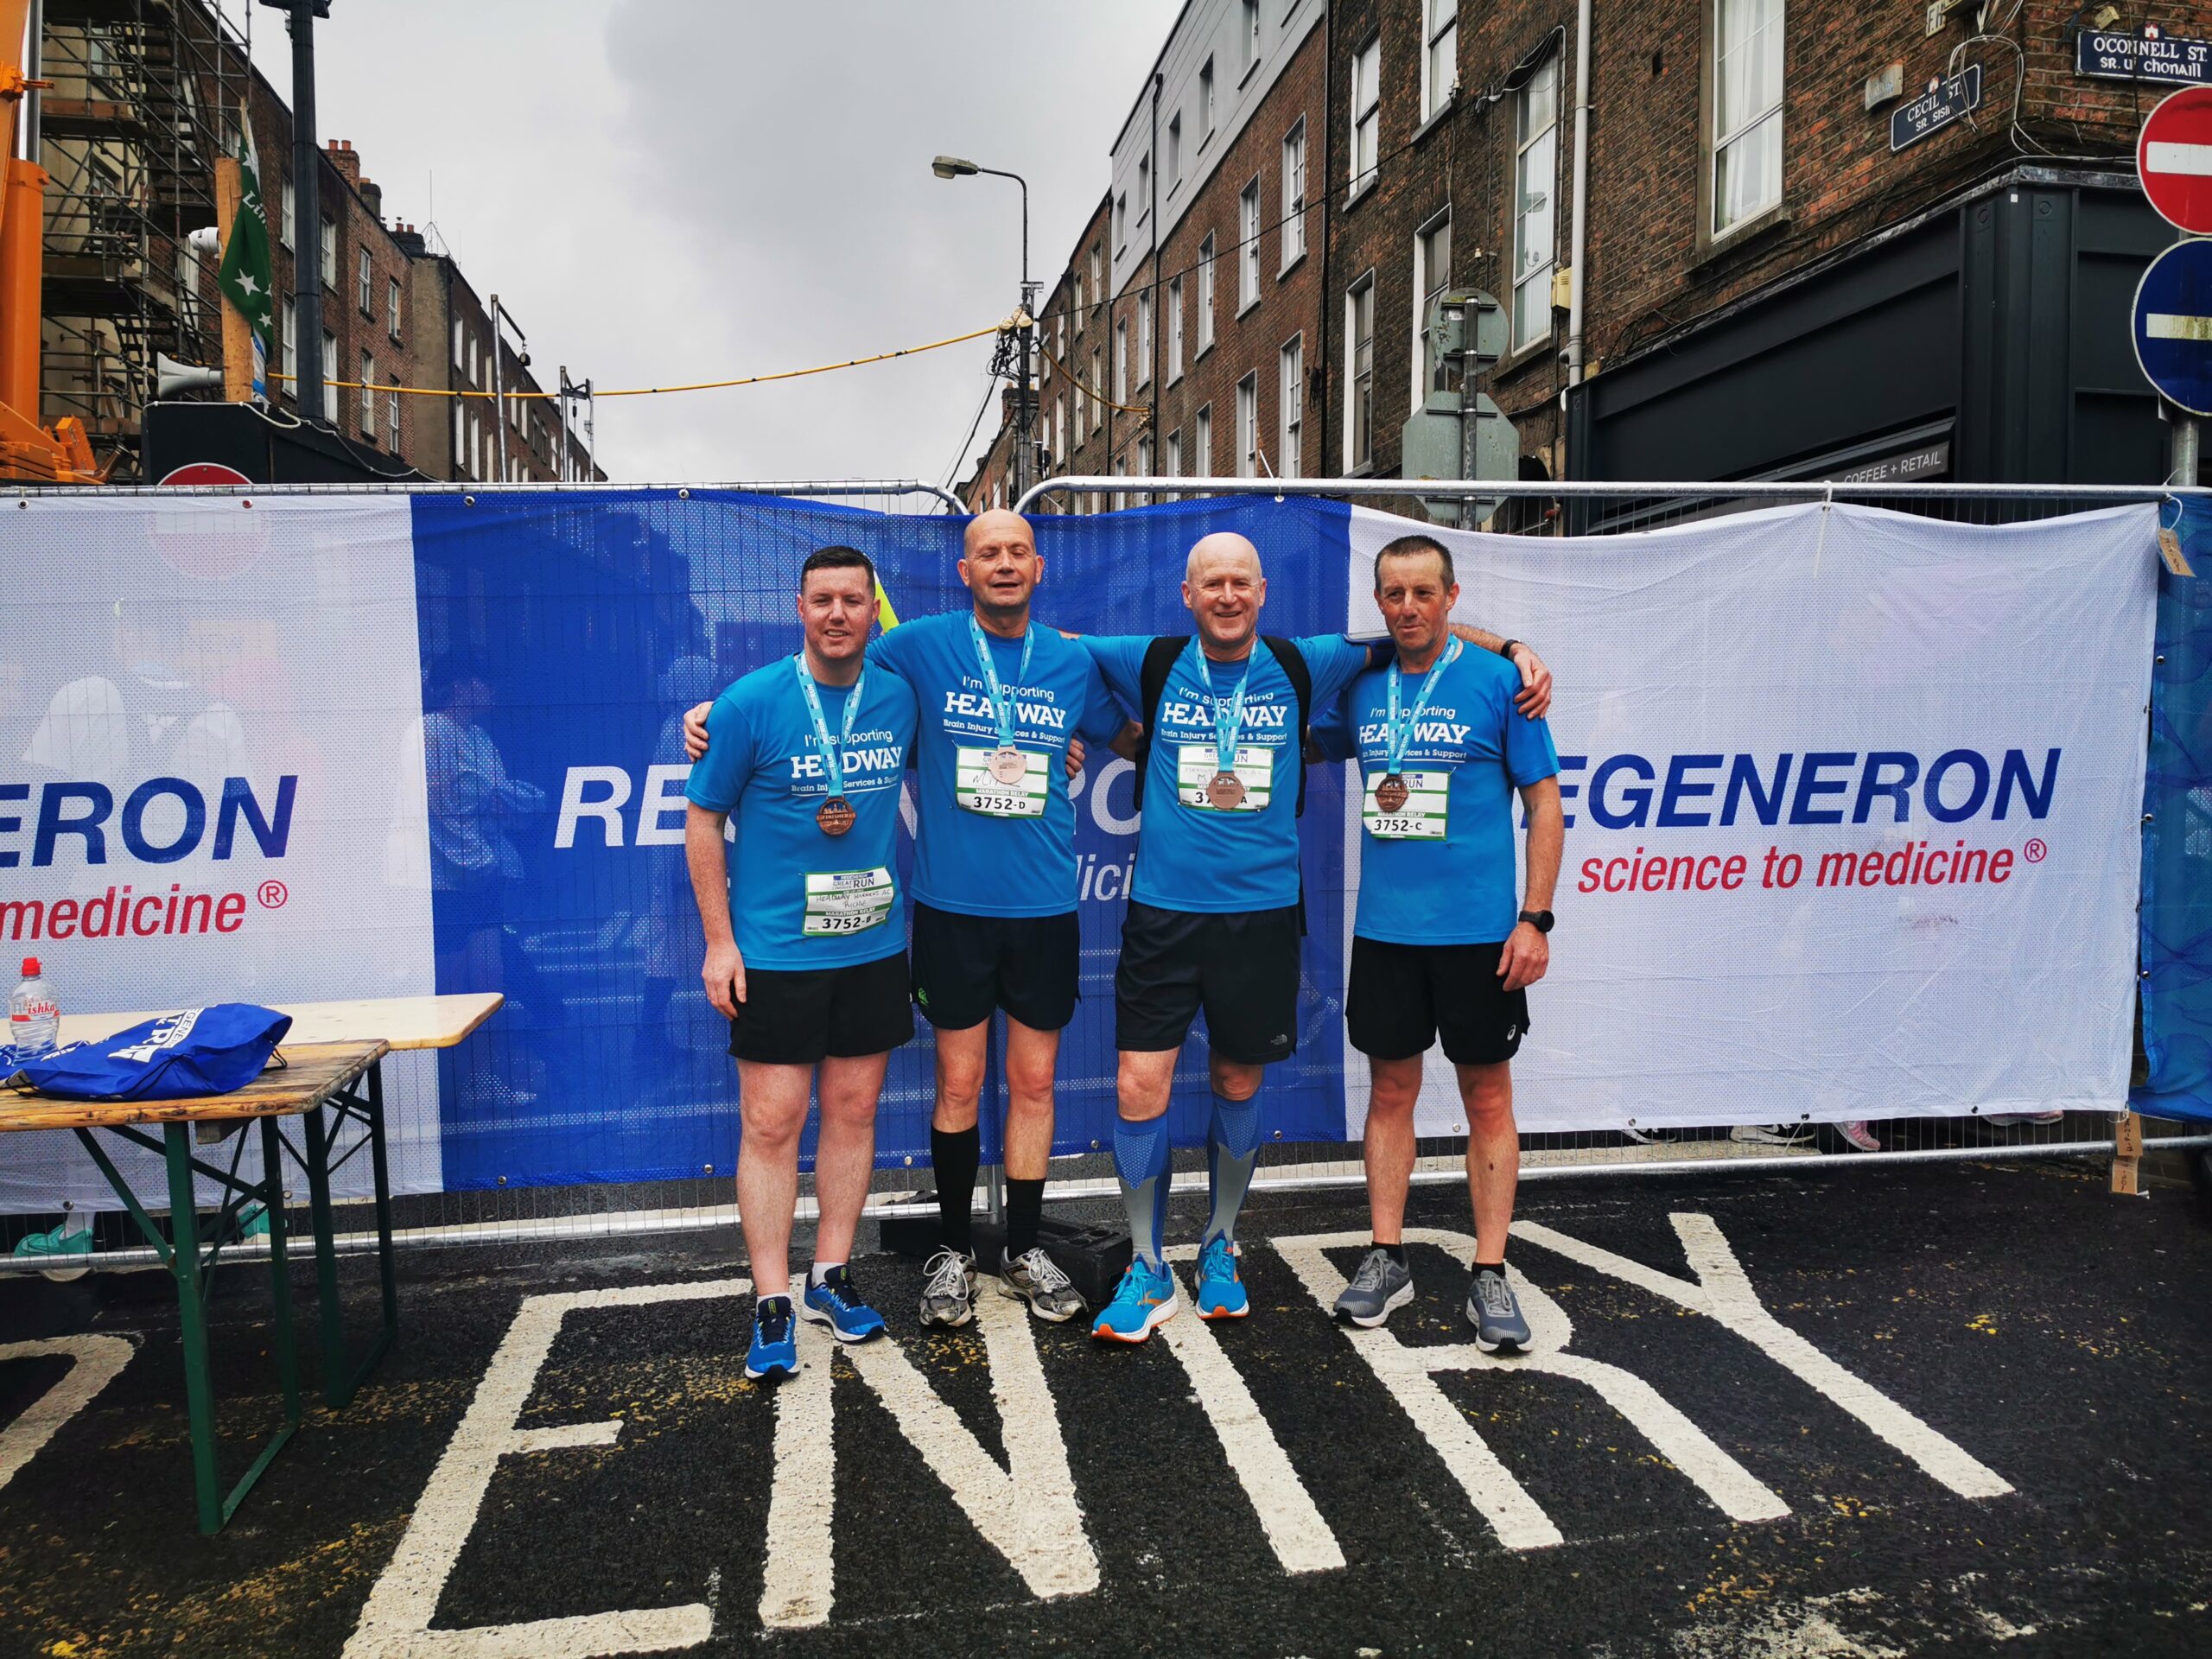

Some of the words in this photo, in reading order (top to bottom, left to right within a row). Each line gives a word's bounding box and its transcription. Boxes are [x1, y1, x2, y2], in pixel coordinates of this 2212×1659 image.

[2187, 46, 2208, 62] ST.
[2100, 56, 2121, 69] SR.
[1907, 94, 1940, 122] CECIL
[1916, 118, 1929, 131] SR.
[1844, 464, 1887, 483] COFFEE
[1901, 451, 1942, 474] RETAIL
[963, 676, 982, 690] I'm
[1370, 707, 1386, 718] I'm
[944, 719, 965, 730] Brain
[967, 721, 993, 734] Injury
[1039, 732, 1065, 744] Support
[1180, 731, 1206, 741] Injury
[1256, 733, 1287, 741] Support
[1359, 722, 1471, 744] HEAWAY
[1433, 748, 1466, 759] Support
[790, 746, 902, 779] HEDWAY
[842, 779, 875, 788] Services
[973, 796, 1026, 810] 3752-D
[1374, 819, 1422, 831] 3752-C
[1578, 846, 1746, 893] science
[1764, 845, 1802, 889] to
[1815, 839, 2014, 888] medicine
[853, 878, 874, 888] RUN
[0, 883, 245, 941] medicine
[28, 1001, 55, 1015] ishka
[340, 1212, 2015, 1659] ENTRY
